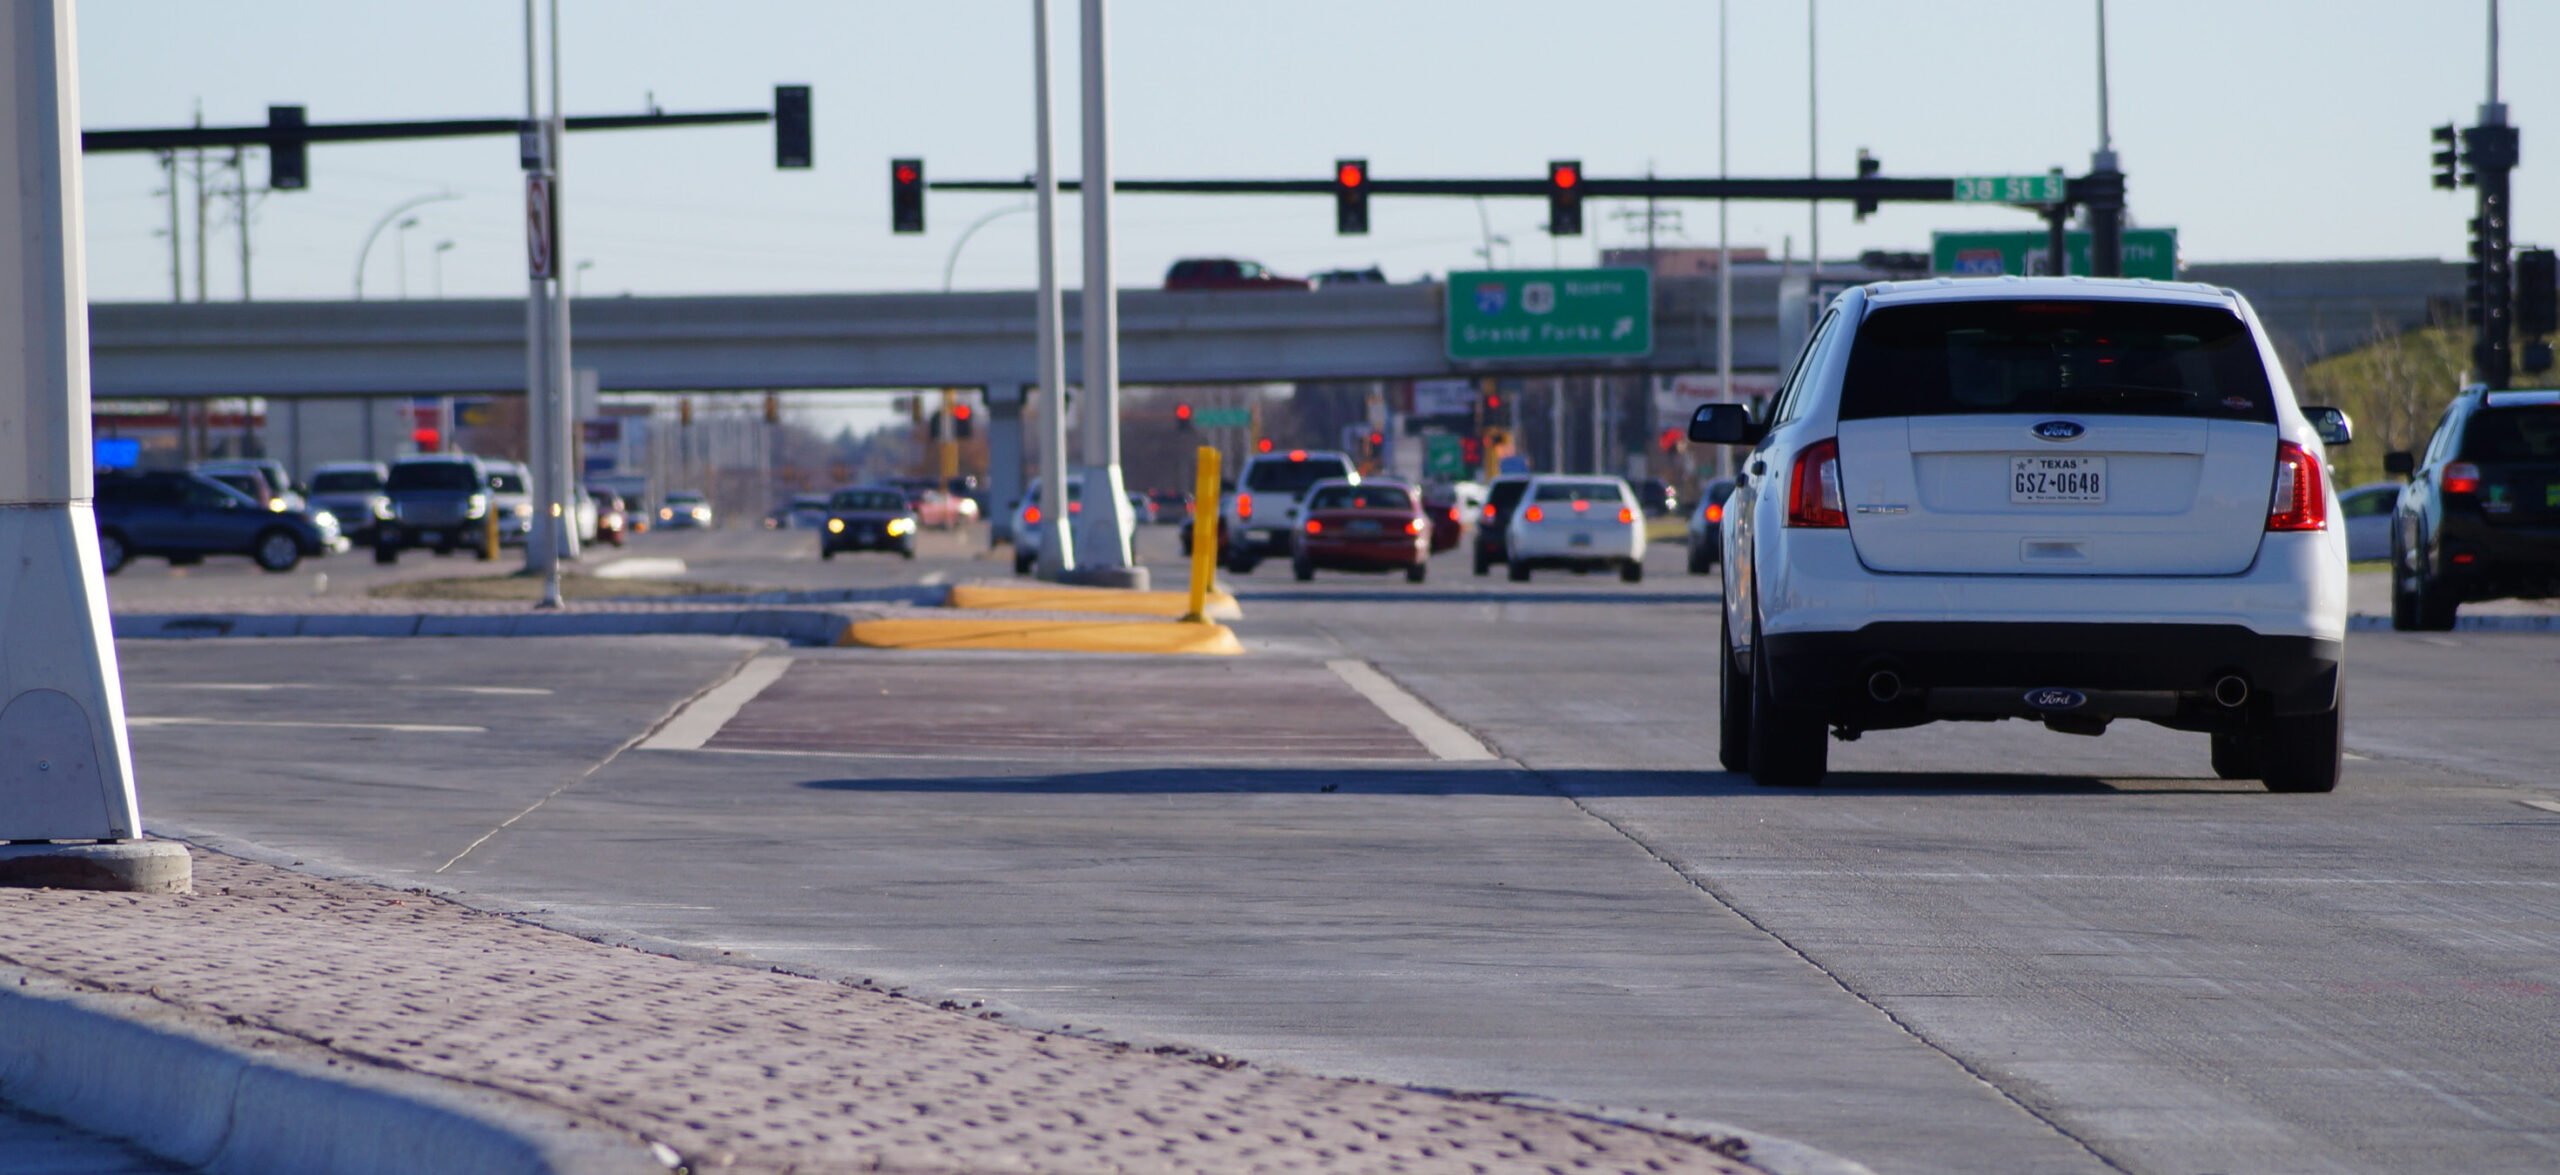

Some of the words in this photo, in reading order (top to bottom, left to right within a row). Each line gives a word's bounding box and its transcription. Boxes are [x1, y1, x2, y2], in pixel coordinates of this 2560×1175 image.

[1957, 179, 1993, 200] 38
[2005, 178, 2032, 199] St
[2044, 177, 2059, 199] S
[1463, 322, 1531, 343] Grand
[2043, 423, 2073, 436] Ford
[2040, 459, 2077, 469] TEXAS
[2039, 690, 2071, 704] Ford
